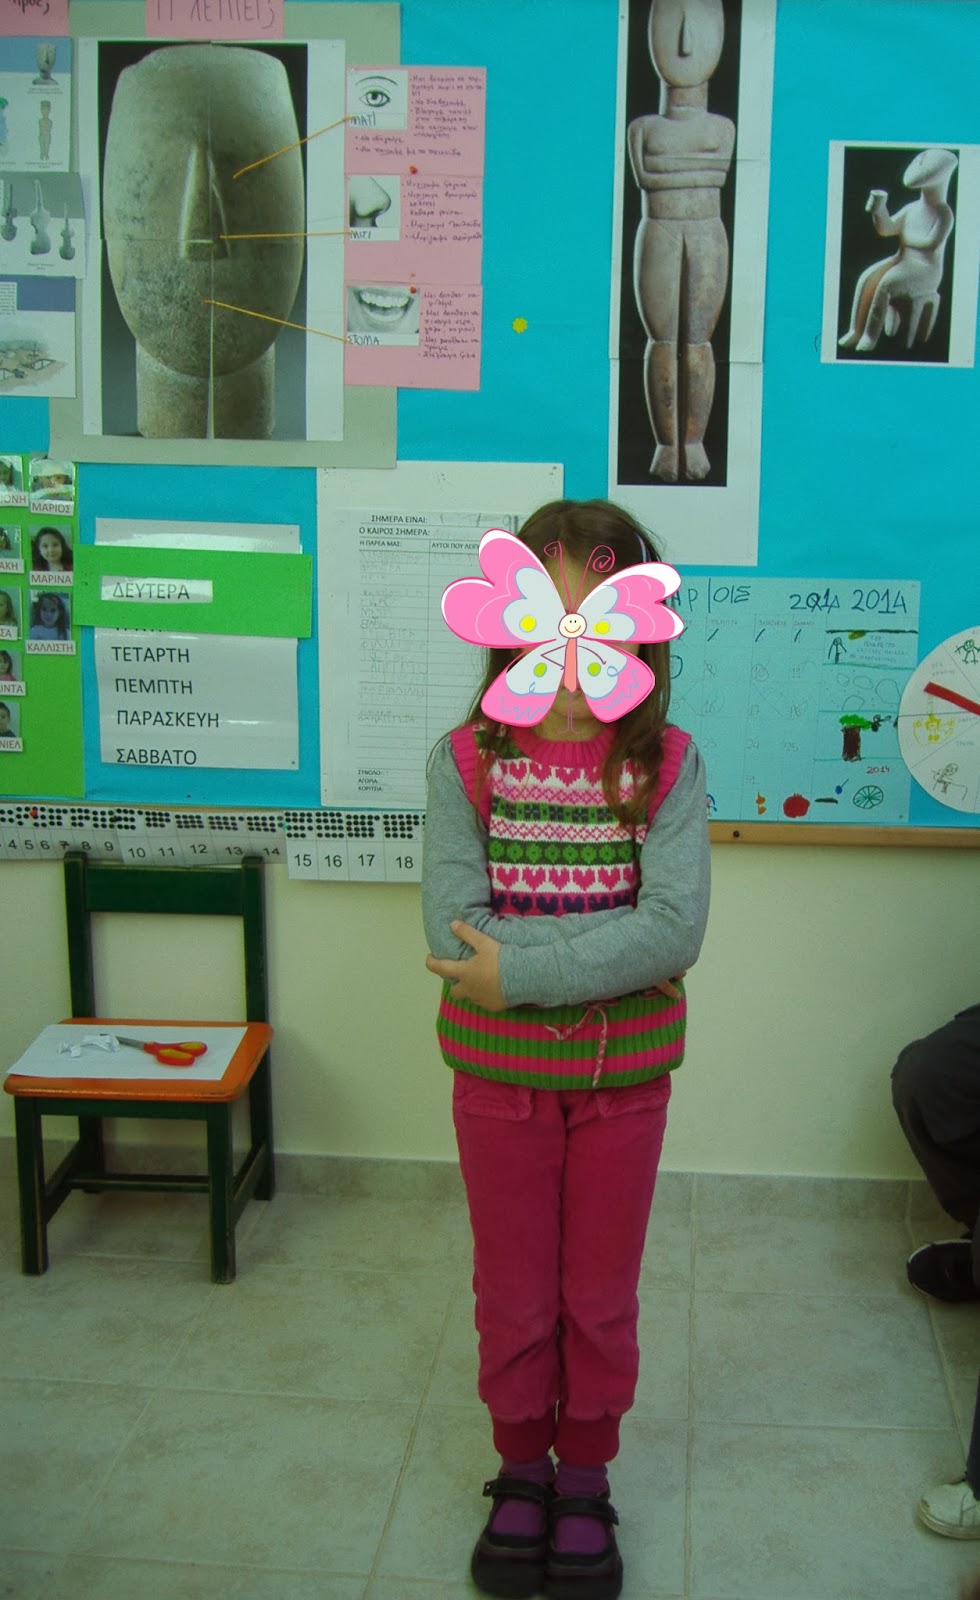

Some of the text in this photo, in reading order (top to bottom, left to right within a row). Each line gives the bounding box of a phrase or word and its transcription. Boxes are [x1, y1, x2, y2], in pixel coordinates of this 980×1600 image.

[31, 502, 72, 514] ΜΑΡΙΟΣ
[371, 514, 404, 523] ΣΗΜΕΡΑ
[31, 574, 72, 584] ΜΑΡΙΝΑ
[112, 581, 191, 600] ΔΕΥΤΕΡΑ
[27, 642, 74, 654] ΚΑΛΛΙΣΤΗ
[111, 646, 190, 664] ΤΕΤΑΡΤΗ
[115, 678, 193, 695] ΠΕΜΠΤΗ
[116, 710, 220, 728] ΠΑΡΑΣΚΕΥΗ
[116, 748, 198, 766] ΣΑΒΒΑΤΟ
[8, 839, 17, 850] 4
[24, 839, 34, 850] 5
[40, 840, 50, 850] 6
[81, 841, 91, 850] 8
[104, 841, 114, 851] 9
[128, 847, 146, 858] 10
[158, 847, 175, 857] 11
[189, 844, 208, 854] 12
[225, 846, 243, 855] 13
[294, 854, 312, 867] 15
[324, 855, 342, 868] 16
[357, 854, 375, 867] 17
[396, 856, 414, 869] 18
